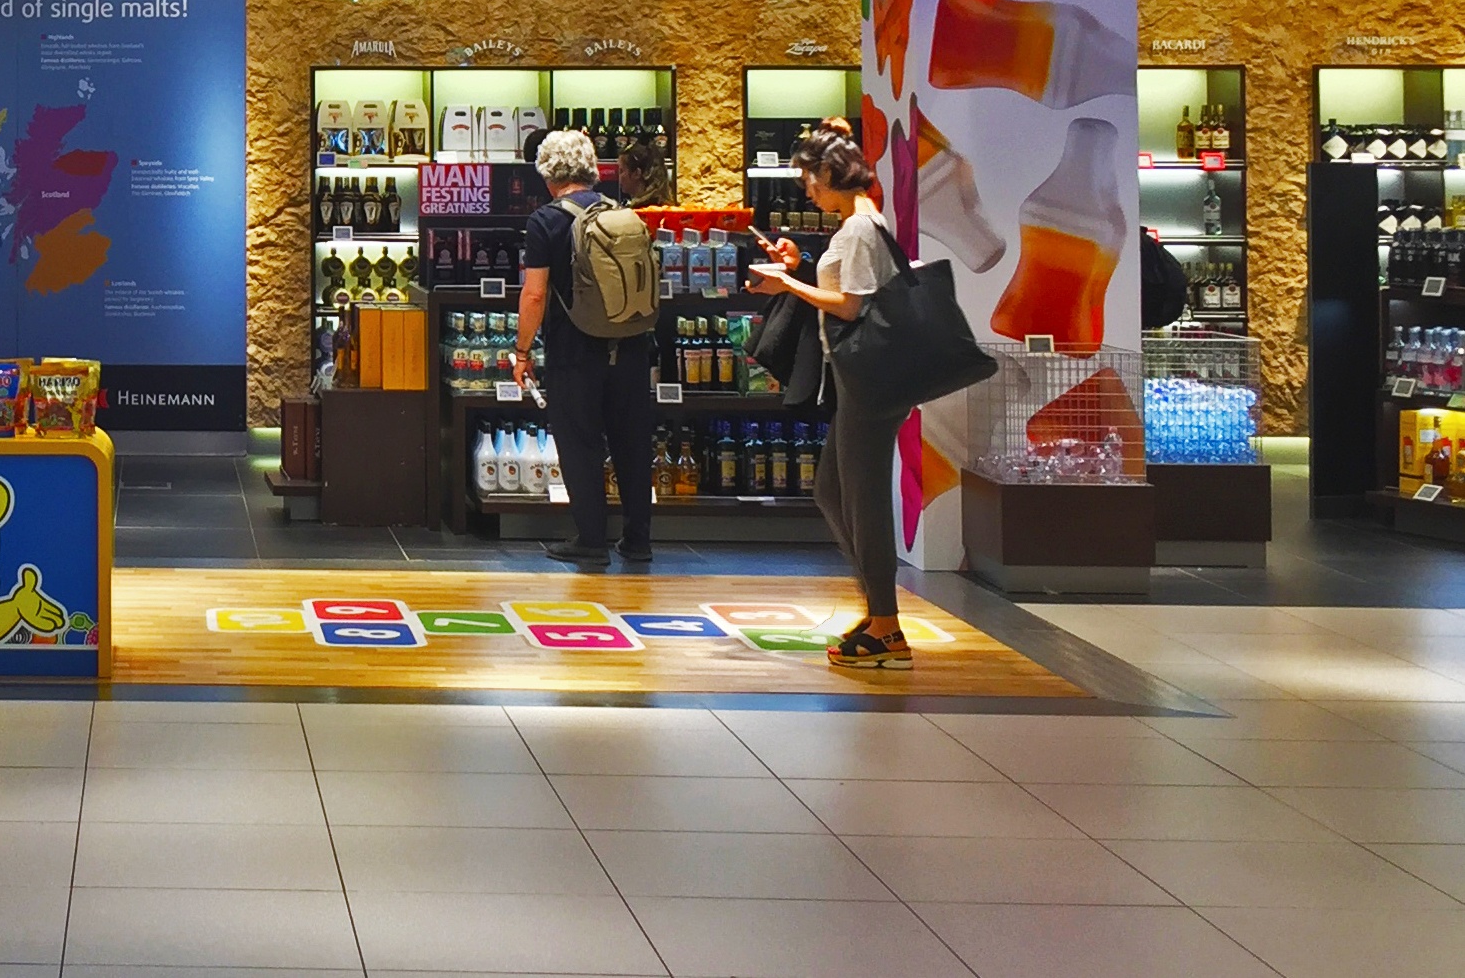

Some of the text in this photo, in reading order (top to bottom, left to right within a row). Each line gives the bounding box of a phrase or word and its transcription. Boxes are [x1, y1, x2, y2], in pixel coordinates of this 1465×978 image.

[463, 38, 523, 57] BAILEYS
[584, 38, 642, 57] BAILEYS
[1152, 39, 1206, 51] BACARDI
[421, 165, 491, 187] MANI
[421, 187, 491, 202] FESTING
[420, 202, 491, 215] GREATNESS
[117, 390, 215, 407] HEINEMANN
